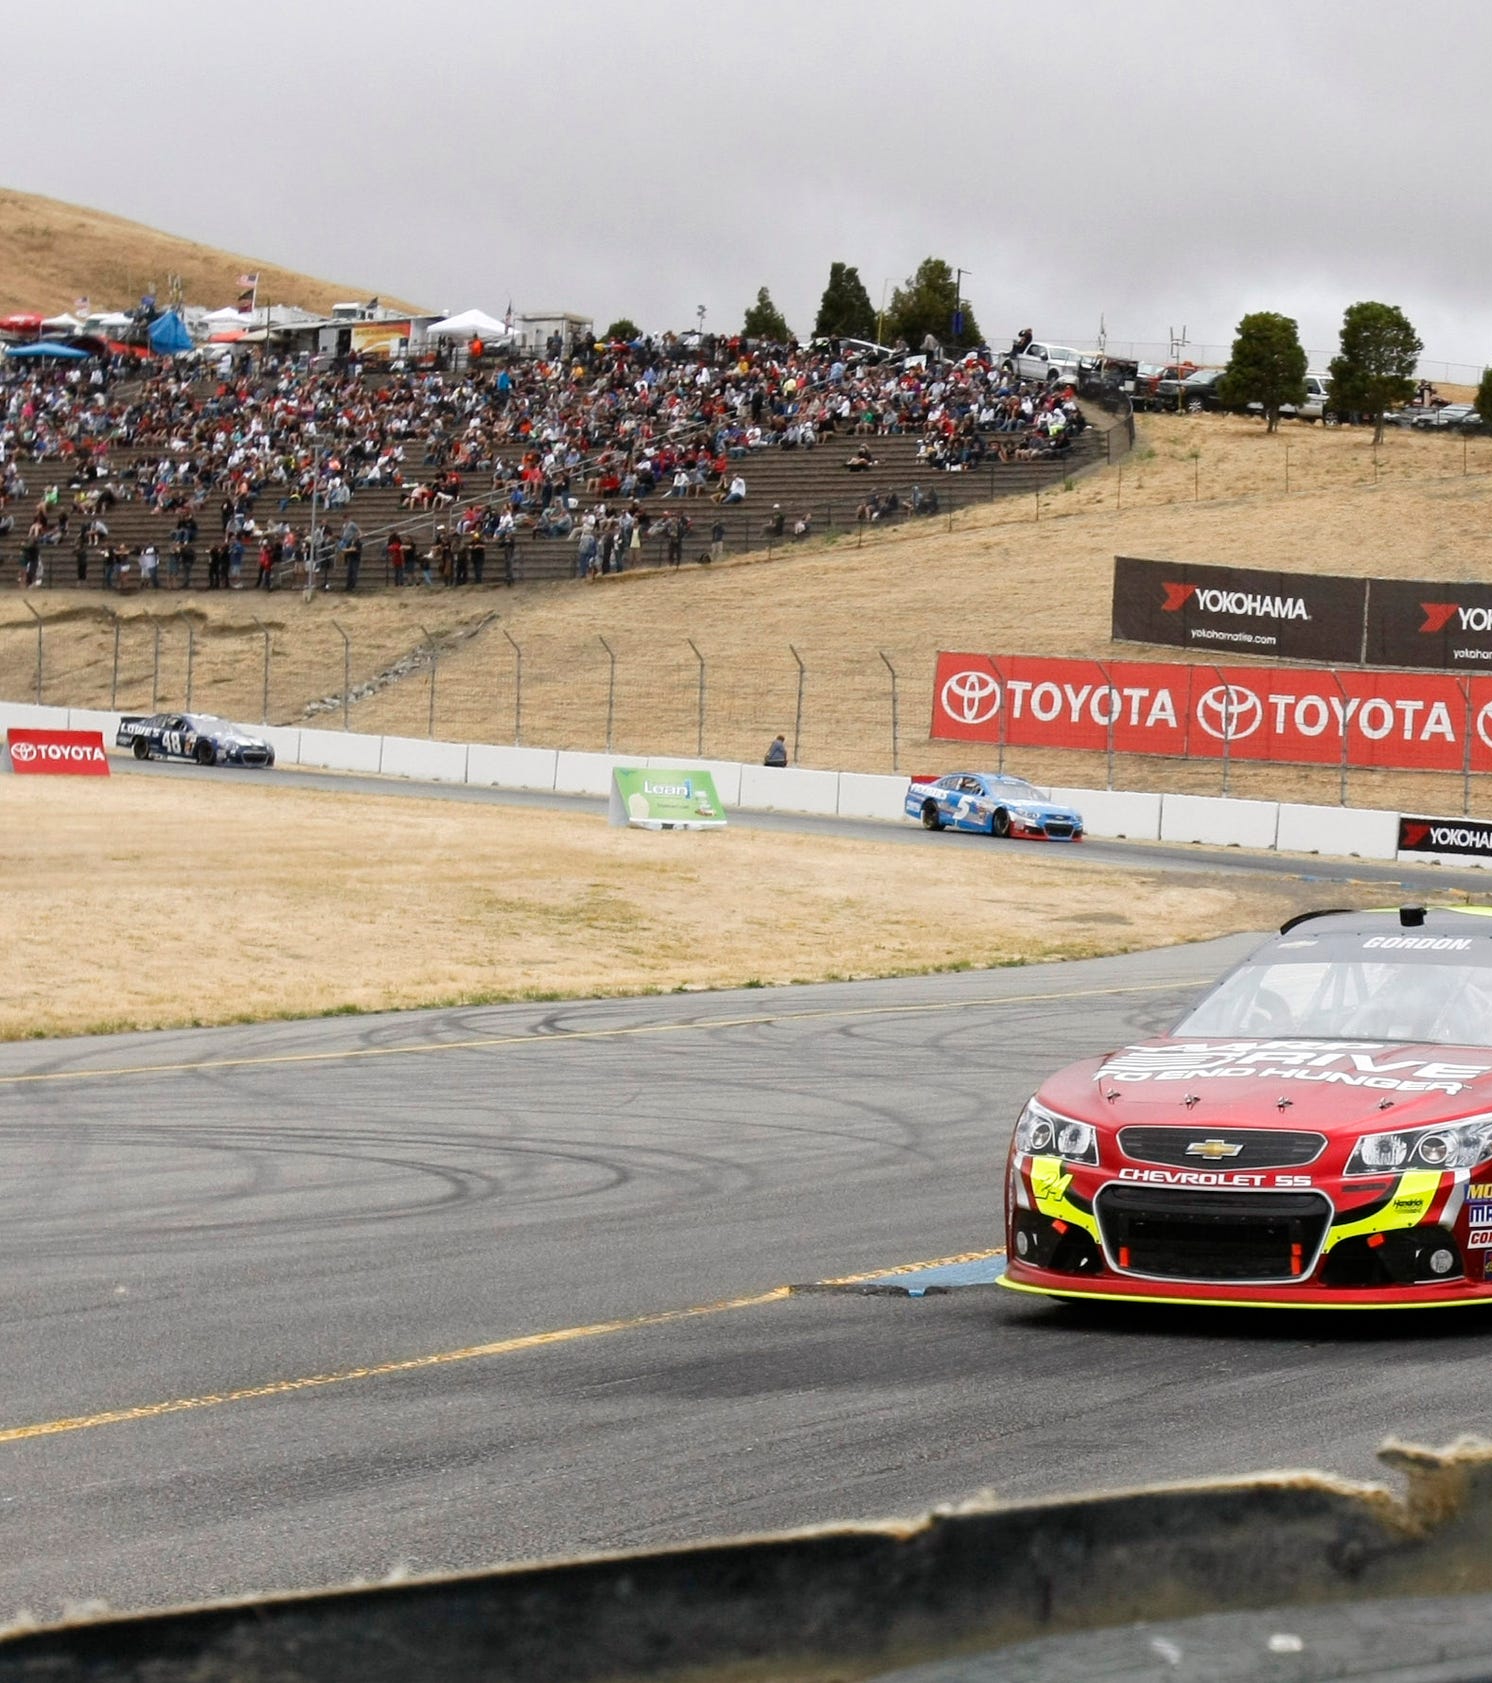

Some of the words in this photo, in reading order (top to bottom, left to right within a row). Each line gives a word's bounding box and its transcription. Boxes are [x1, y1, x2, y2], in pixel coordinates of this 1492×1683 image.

[1195, 588, 1309, 621] YOKOHAMA
[1191, 628, 1277, 646] yokohamatire.com
[1006, 680, 1178, 728] TOYOTA
[1269, 694, 1456, 742] TOYOTA
[37, 744, 106, 761] TOYOTA
[162, 730, 181, 753] 48
[952, 795, 975, 820] 5
[1092, 1070, 1152, 1082] TO
[1154, 1067, 1257, 1080] END
[1258, 1068, 1466, 1096] HUNGER
[1034, 1170, 1074, 1202] 24
[1118, 1168, 1266, 1187] CHEVROLET
[1274, 1175, 1312, 1187] SS
